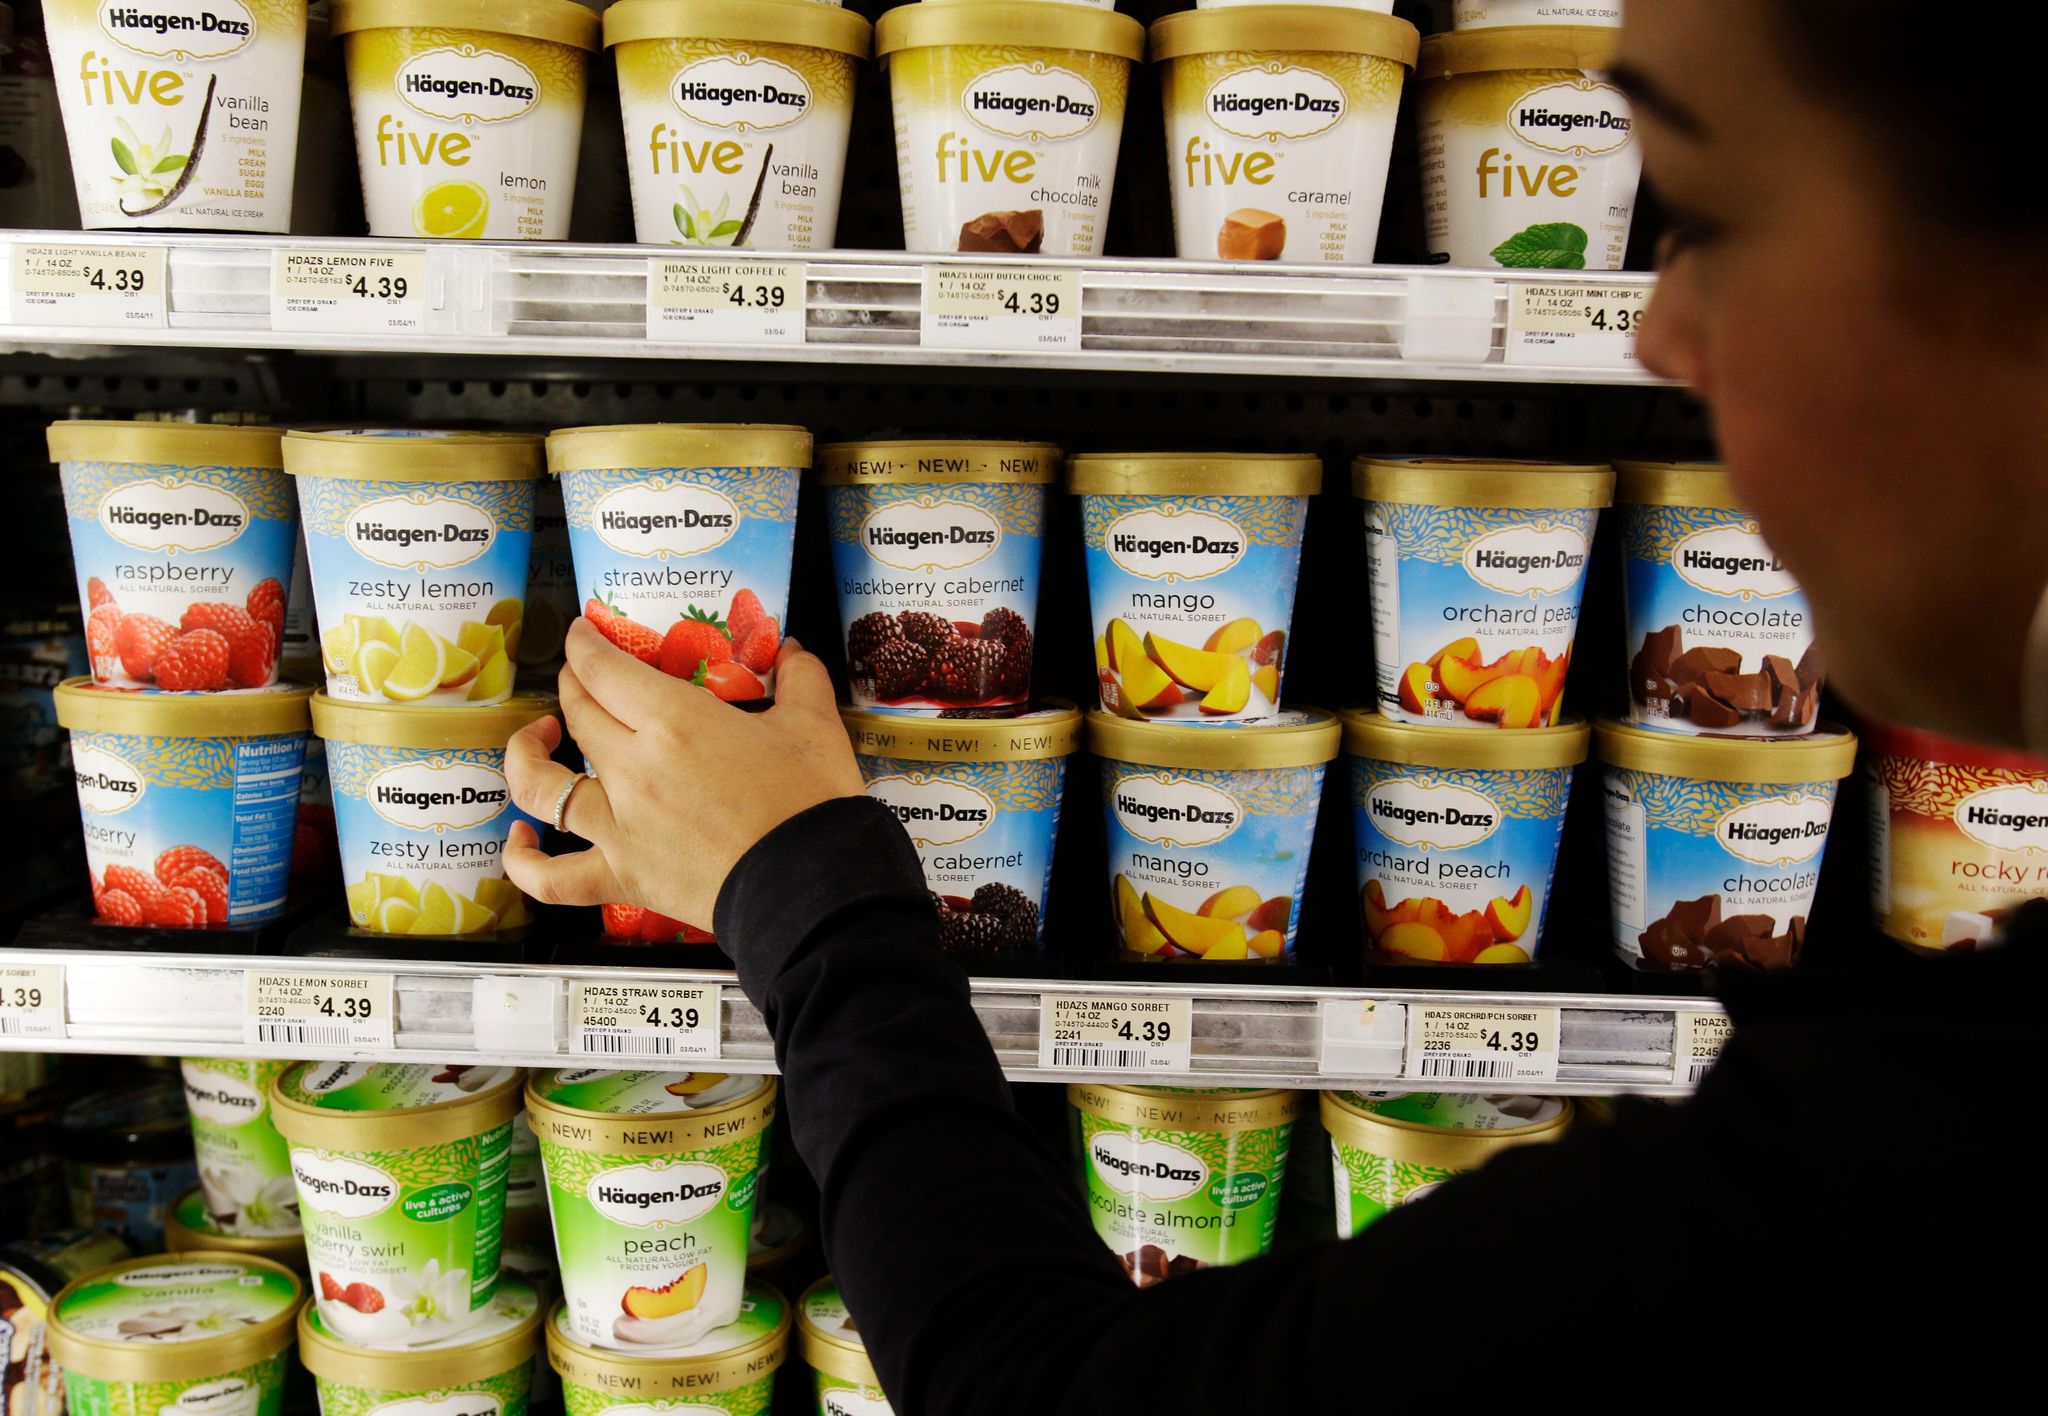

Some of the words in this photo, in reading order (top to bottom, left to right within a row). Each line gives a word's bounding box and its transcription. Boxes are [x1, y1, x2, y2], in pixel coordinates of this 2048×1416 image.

[110, 8, 249, 36] Häagen-Dazs
[1586, 9, 1596, 17] ICE
[80, 51, 184, 106] five
[406, 75, 533, 100] Häagen-Dazs
[217, 96, 269, 112] vanilla
[681, 83, 806, 107] Häagen-Dazs
[973, 92, 1094, 117] Häagen-Dazs
[1213, 93, 1340, 116] Häagen-Dazs
[230, 114, 268, 131] bean
[377, 114, 471, 166] five
[650, 123, 744, 175] five
[248, 149, 266, 157] MILK
[936, 131, 1036, 184] five
[1186, 136, 1275, 188] five
[239, 159, 265, 168] CREAM
[772, 163, 818, 180] vanilla
[1477, 147, 1579, 198] five
[239, 169, 265, 177] SUGAR
[500, 172, 546, 190] lemon
[1077, 175, 1100, 189] milk
[204, 188, 241, 197] VANILLA
[244, 190, 264, 198] BEAN
[245, 180, 264, 188] EGGS
[782, 181, 816, 198] bean
[1031, 188, 1098, 208] chocolate
[1288, 191, 1351, 205] caramel
[196, 208, 230, 217] NATURAL
[244, 210, 263, 218] CREAM
[1609, 204, 1629, 218] mint
[288, 256, 323, 265] HDAZS
[327, 257, 366, 266] LEMON
[702, 265, 731, 274] LIGHT
[736, 267, 774, 276] COFFEE
[1526, 288, 1556, 296] HDAZS
[1559, 289, 1583, 297] LIGHT
[848, 462, 892, 474] NEW!
[918, 459, 969, 472] NEW!
[1000, 459, 1039, 473] NEW!
[110, 506, 242, 530] Häagen-Dazs
[602, 509, 732, 533] Häagen-Dazs
[356, 522, 489, 546] Häagen-Dazs
[869, 526, 994, 549] Häagen-Dazs
[1114, 534, 1239, 558] Häagen-Dazs
[115, 562, 234, 584] raspberry
[604, 567, 733, 588] strawberry
[119, 584, 136, 592] ALL
[139, 585, 185, 593] NATURAL
[190, 585, 229, 593] SORBET
[350, 580, 410, 601] zesty
[421, 579, 493, 597] lemon
[845, 579, 936, 598] blackberry
[944, 576, 1024, 594] cabernet
[1132, 593, 1214, 612] mango
[1123, 612, 1137, 620] ALL
[1140, 613, 1184, 621] NATURAL
[1188, 613, 1226, 621] SORBET
[1443, 605, 1537, 623] orchard
[1683, 605, 1802, 627] chocolate
[239, 743, 292, 758] Nutrition
[856, 732, 896, 748] NEW!
[928, 739, 979, 751] NEW!
[1011, 736, 1052, 751] NEW!
[377, 786, 506, 809] Häagen-Dazs
[1118, 795, 1234, 824] Häagen-Dazs
[1372, 798, 1492, 826] Häagen-Dazs
[371, 840, 429, 861] zesty
[933, 851, 1023, 870] cabernet
[1132, 853, 1209, 877] mango
[1360, 848, 1429, 874] orchard
[1439, 861, 1510, 879] peach
[937, 874, 975, 882] SORBET
[1952, 860, 2027, 884] rocky
[1440, 881, 1479, 890] SORBET
[1723, 872, 1816, 892] chocolate
[259, 978, 290, 986] HDAZS
[294, 979, 327, 987] LEMON
[331, 980, 368, 988] SORBET
[584, 988, 618, 996] HDAZS
[622, 989, 658, 997] STRAW
[662, 990, 703, 998] SORBET
[259, 1007, 284, 1016] 2240
[1056, 1001, 1088, 1009] HDAZS
[1092, 1002, 1127, 1011] MANGO
[1131, 1003, 1170, 1012] SORBET
[584, 1017, 617, 1026] 45400
[1694, 1018, 1727, 1026] HDAZS
[1055, 1031, 1081, 1039] 2241
[1424, 1041, 1450, 1050] 2236
[1693, 1047, 1718, 1056] 2245
[1080, 1090, 1110, 1110] NEW!
[1137, 1106, 1182, 1122] NEW!
[1214, 1110, 1258, 1123] NEW!
[552, 1122, 592, 1142] NEW!
[623, 1131, 674, 1144] NEW!
[704, 1118, 745, 1138] NEW!
[598, 1181, 721, 1208] Häagen-Dazs
[1212, 1185, 1230, 1195] live
[1240, 1181, 1266, 1192] active
[405, 1200, 427, 1210] live
[437, 1190, 470, 1204] active
[1222, 1193, 1257, 1204] cultures
[416, 1203, 462, 1219] cultures
[1154, 1211, 1236, 1228] almond
[315, 1222, 362, 1241] vanilla
[362, 1244, 404, 1256] swirl
[624, 1233, 696, 1255] peach
[621, 1263, 658, 1271] FROZEN
[662, 1258, 699, 1270] YOGURT
[625, 1255, 671, 1263] NATURAL
